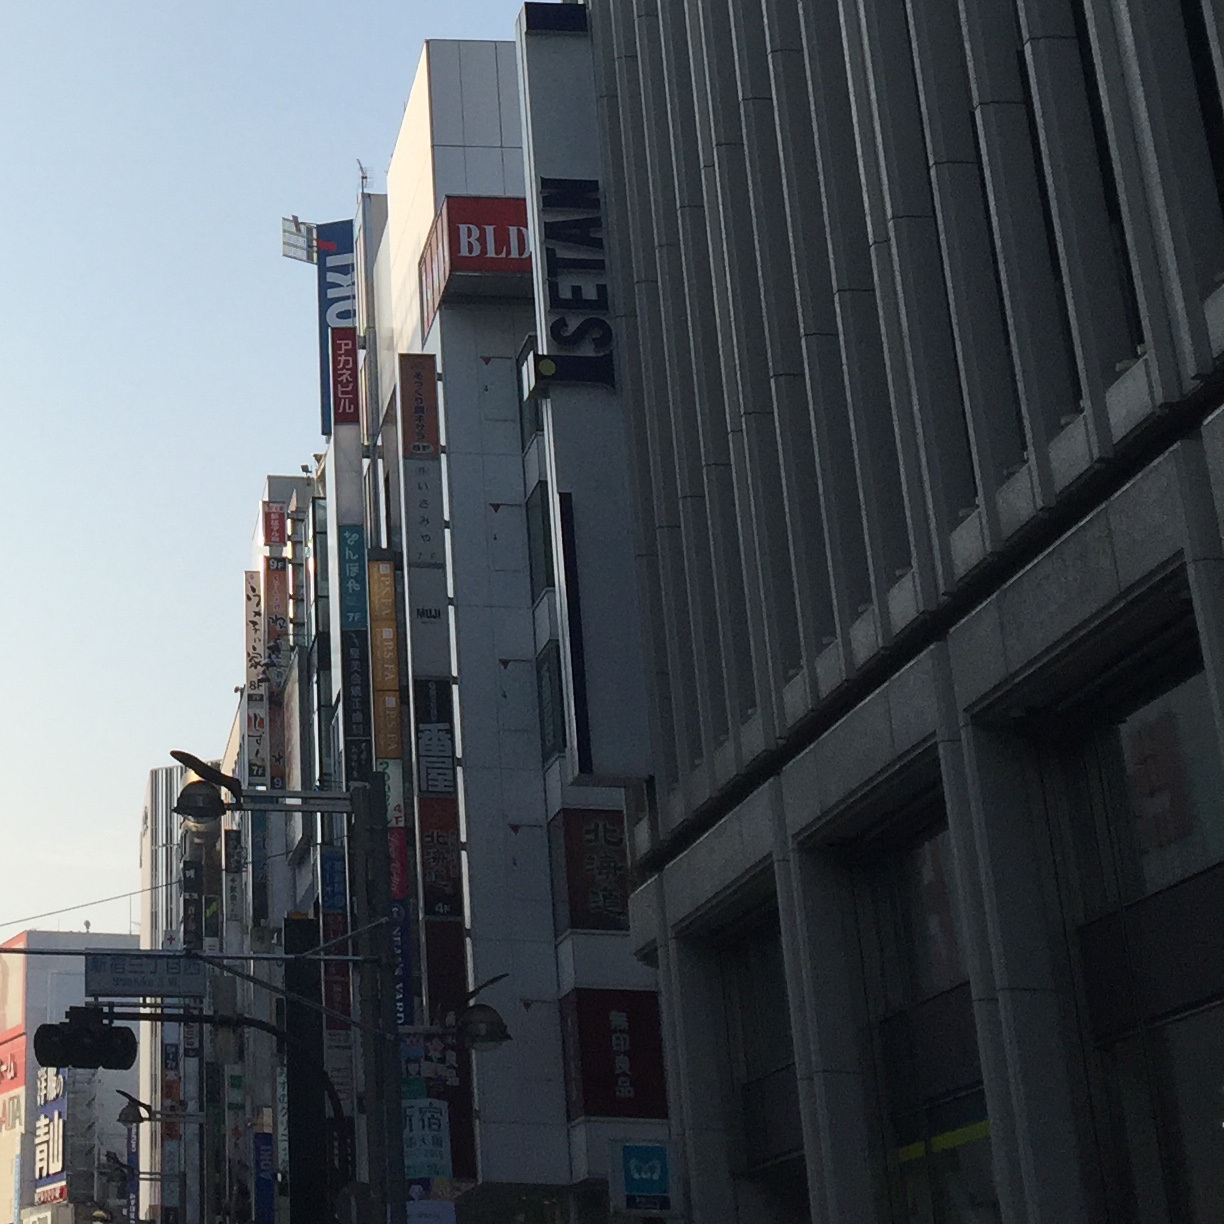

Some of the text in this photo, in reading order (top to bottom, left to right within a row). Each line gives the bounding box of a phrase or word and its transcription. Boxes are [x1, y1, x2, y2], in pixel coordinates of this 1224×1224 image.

[541, 176, 616, 389] ISETAN
[336, 340, 354, 414] アカネビル
[269, 558, 285, 571] 9F
[416, 608, 441, 620] MUJI
[417, 723, 455, 794] 番屋
[609, 1010, 635, 1099] 無印良品
[34, 1109, 64, 1180] 青山
